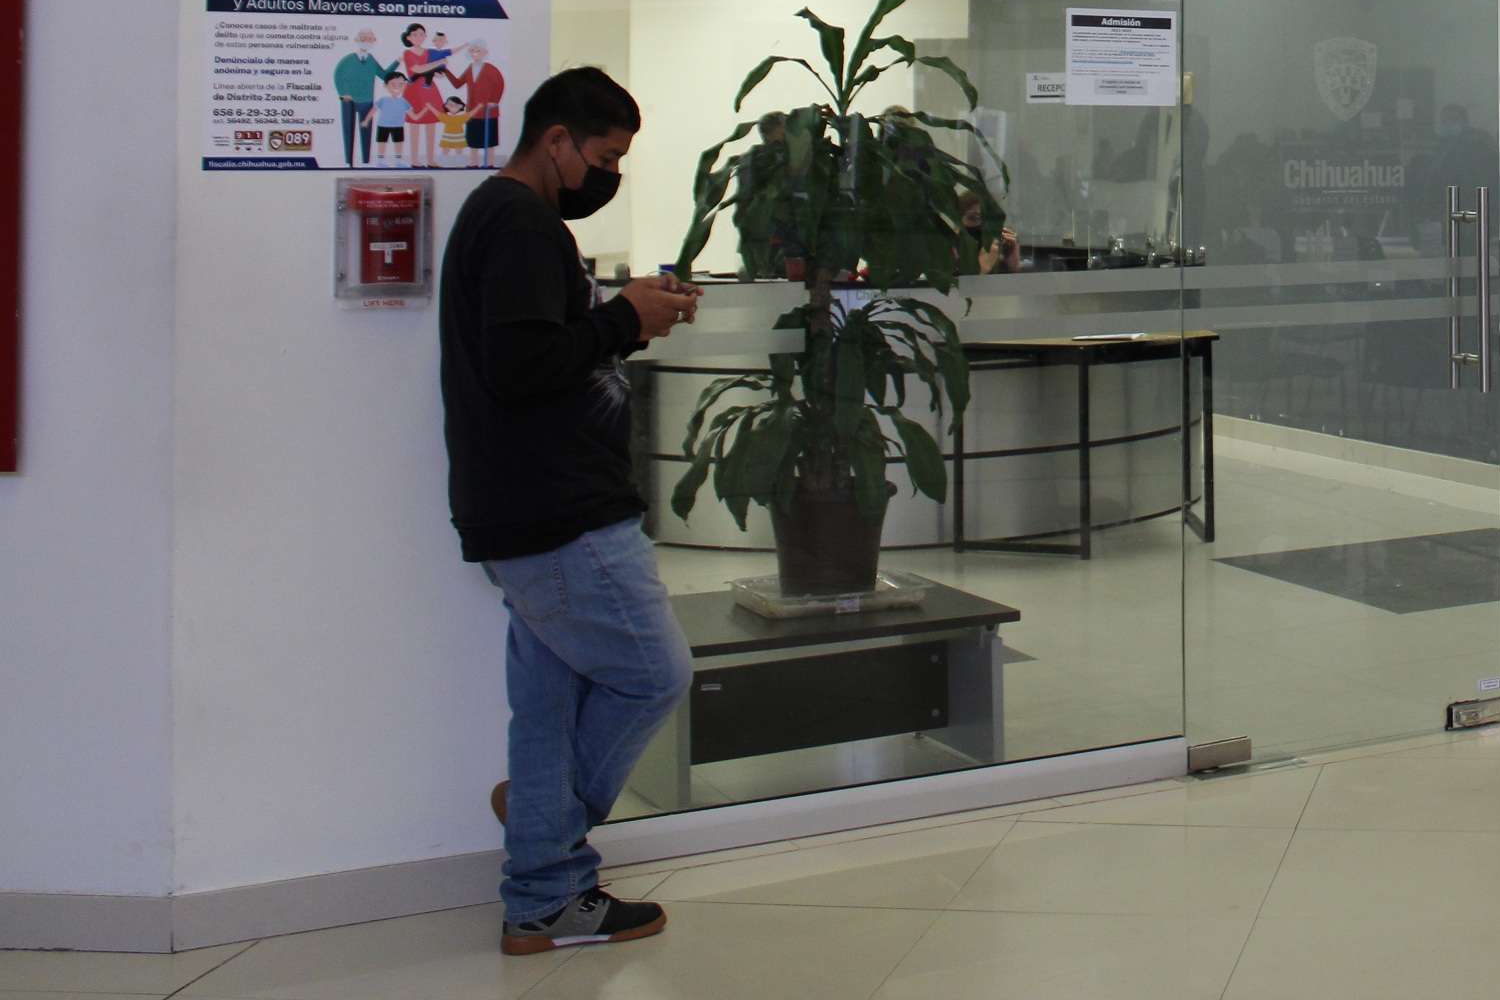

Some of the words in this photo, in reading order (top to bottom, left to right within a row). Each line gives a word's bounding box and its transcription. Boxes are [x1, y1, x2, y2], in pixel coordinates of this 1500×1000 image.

[233, 0, 243, 11] y
[379, 3, 405, 14] son
[407, 1, 465, 16] primero
[1101, 18, 1141, 27] Admisión
[214, 55, 262, 65] Denúncialo
[264, 57, 275, 65] de
[214, 66, 252, 75] anónima
[260, 68, 289, 76] segura
[304, 67, 312, 75] la
[213, 93, 224, 101] de
[226, 93, 262, 101] Distrito
[286, 132, 310, 144] 089
[1284, 159, 1406, 188] Chihuahua
